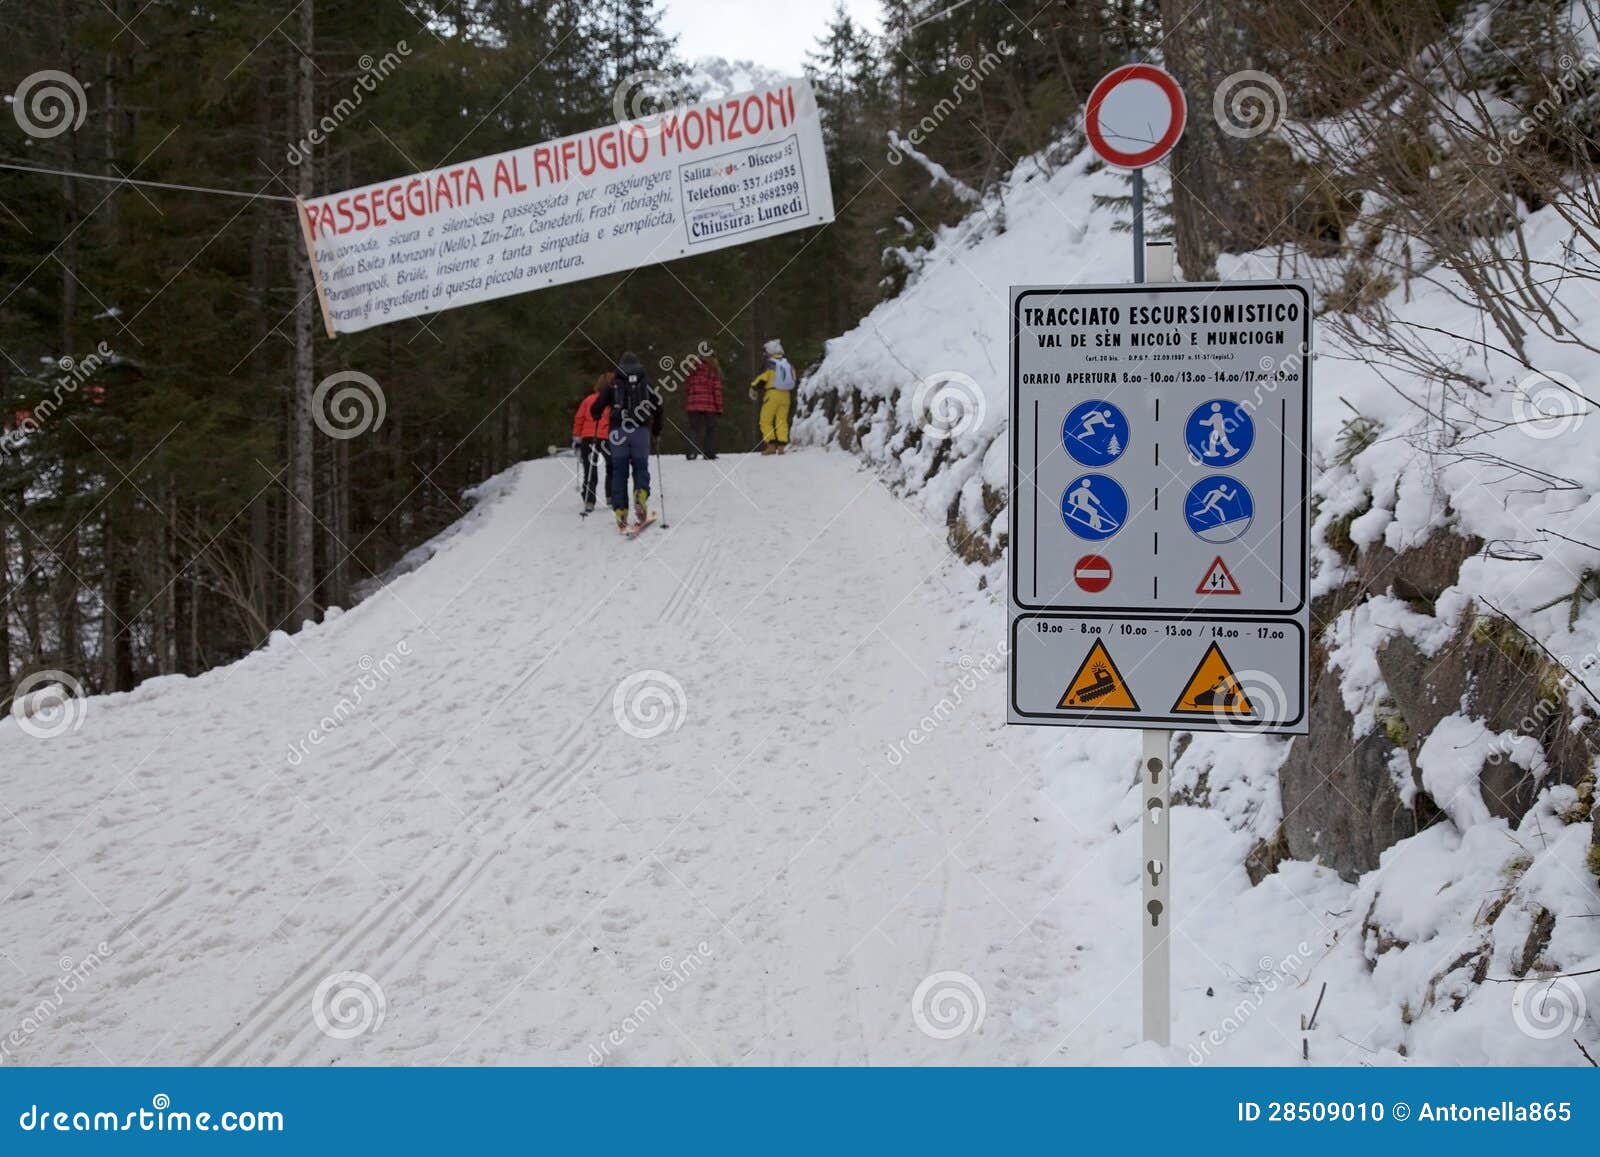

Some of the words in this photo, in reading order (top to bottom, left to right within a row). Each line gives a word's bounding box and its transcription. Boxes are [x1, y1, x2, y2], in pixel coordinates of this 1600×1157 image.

[305, 166, 484, 241] PASSEGGIATA
[494, 155, 527, 197] AL
[534, 124, 648, 187] RIFUGIO
[660, 85, 796, 157] MONZONI
[388, 230, 420, 247] sicura
[428, 226, 434, 237] e
[442, 212, 494, 234] silenziosa
[502, 192, 568, 222] passeggiata
[576, 187, 597, 206] per
[604, 170, 672, 198] raggiungere
[686, 184, 740, 202] Telefono:
[388, 243, 436, 266] Monzoni
[589, 198, 616, 220] Frati
[692, 214, 754, 238] Chiusura:
[436, 257, 480, 276] insieme
[486, 254, 494, 265] a
[502, 242, 532, 262] tanta
[540, 230, 590, 253] simpatia
[596, 227, 604, 240] e
[374, 284, 430, 314] ingredienti
[432, 280, 442, 298] di
[446, 274, 482, 299] questa
[484, 264, 523, 290] piccola
[526, 255, 585, 278] avventura.
[1024, 307, 1120, 326] TRACCIATO
[1130, 304, 1298, 325] ESCURSIONISTICO
[1038, 334, 1062, 348] VAL
[1070, 334, 1087, 347] DE
[1130, 328, 1181, 347] NICOLÒ
[1190, 332, 1198, 346] E
[1207, 330, 1284, 346] MUNCIOGN
[1022, 373, 1060, 384] ORARIO
[1066, 372, 1117, 384] APERTURA
